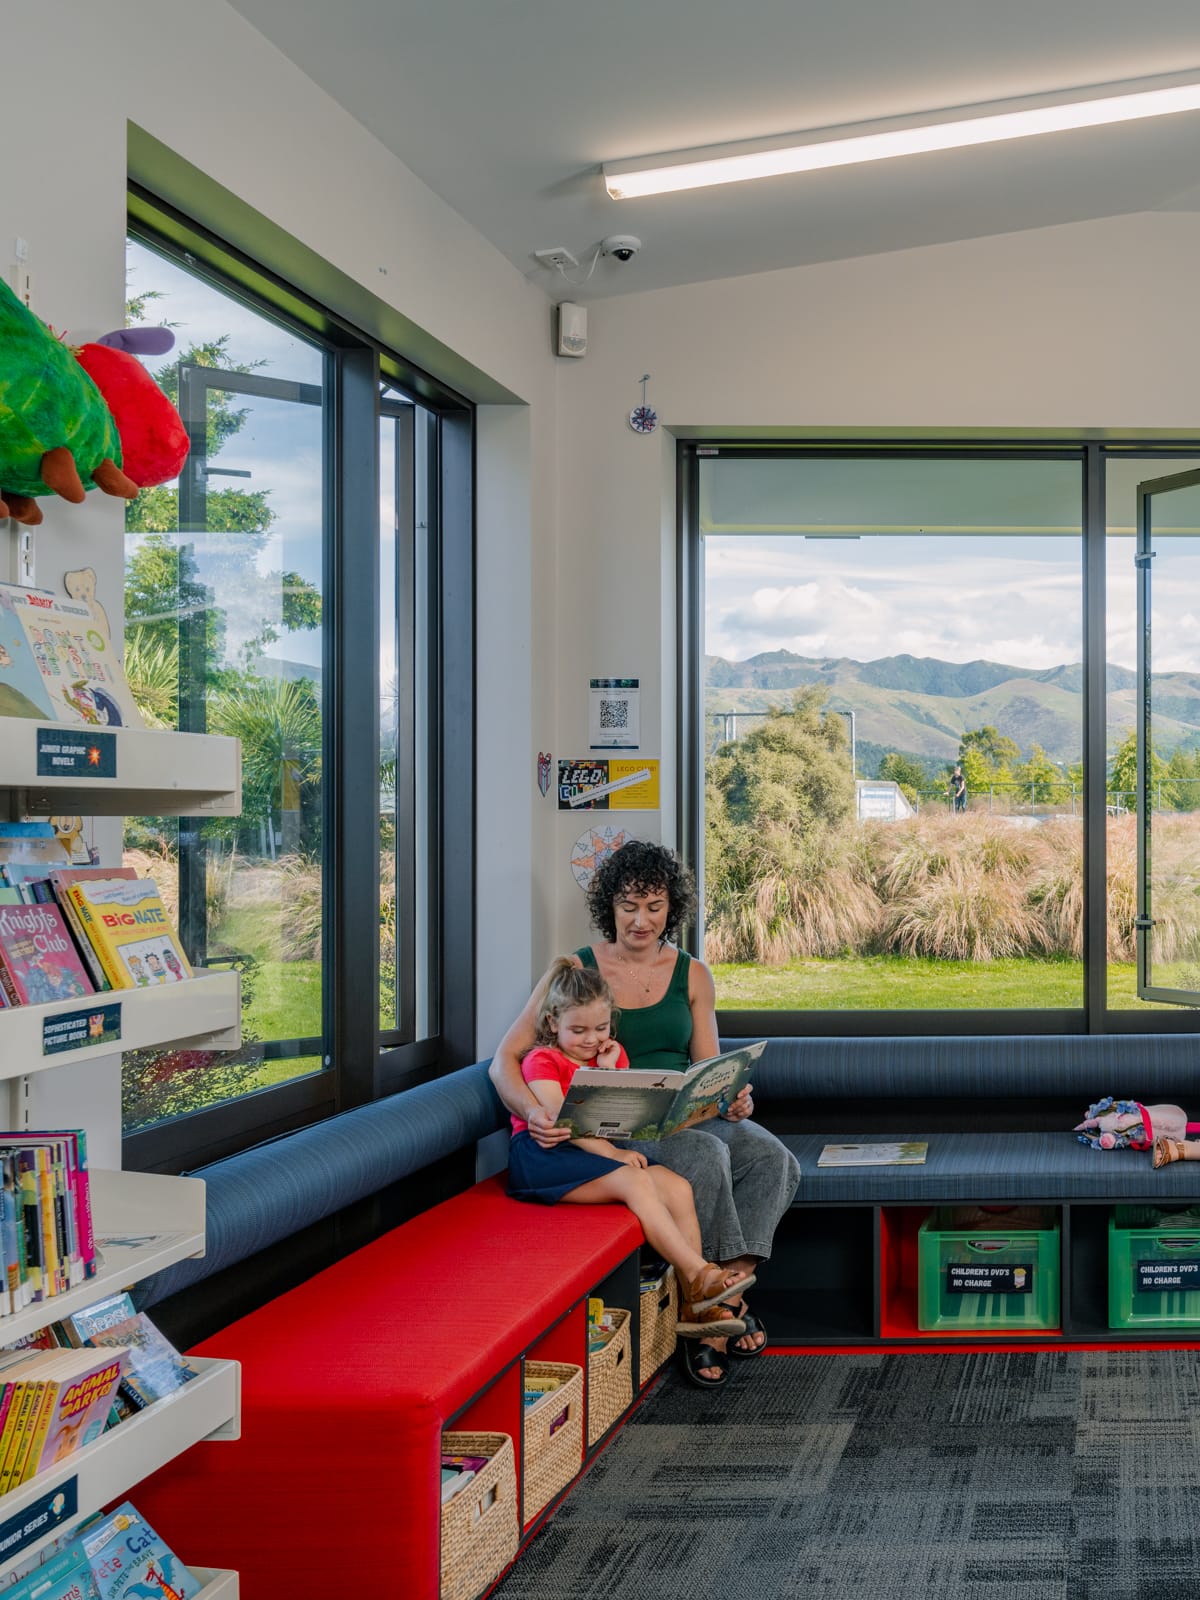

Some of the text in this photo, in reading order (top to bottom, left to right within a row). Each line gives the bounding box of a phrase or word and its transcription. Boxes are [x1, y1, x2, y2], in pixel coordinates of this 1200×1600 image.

[62, 746, 86, 754] GRAPHIC
[52, 756, 74, 766] NOVELS
[562, 768, 602, 784] LEGO
[0, 908, 58, 936] Knights
[134, 908, 165, 924] NATE
[33, 934, 68, 953] Club
[44, 1018, 88, 1034] SOPHISTICATED
[44, 1030, 88, 1046] PICTURE BOOKS
[951, 1268, 989, 1276] CHILDREN'S
[60, 1362, 120, 1406] ANIMAL
[0, 1512, 48, 1552] UNIOR SERIES
[126, 1528, 158, 1554] Cat
[133, 1549, 154, 1567] BRAVE
